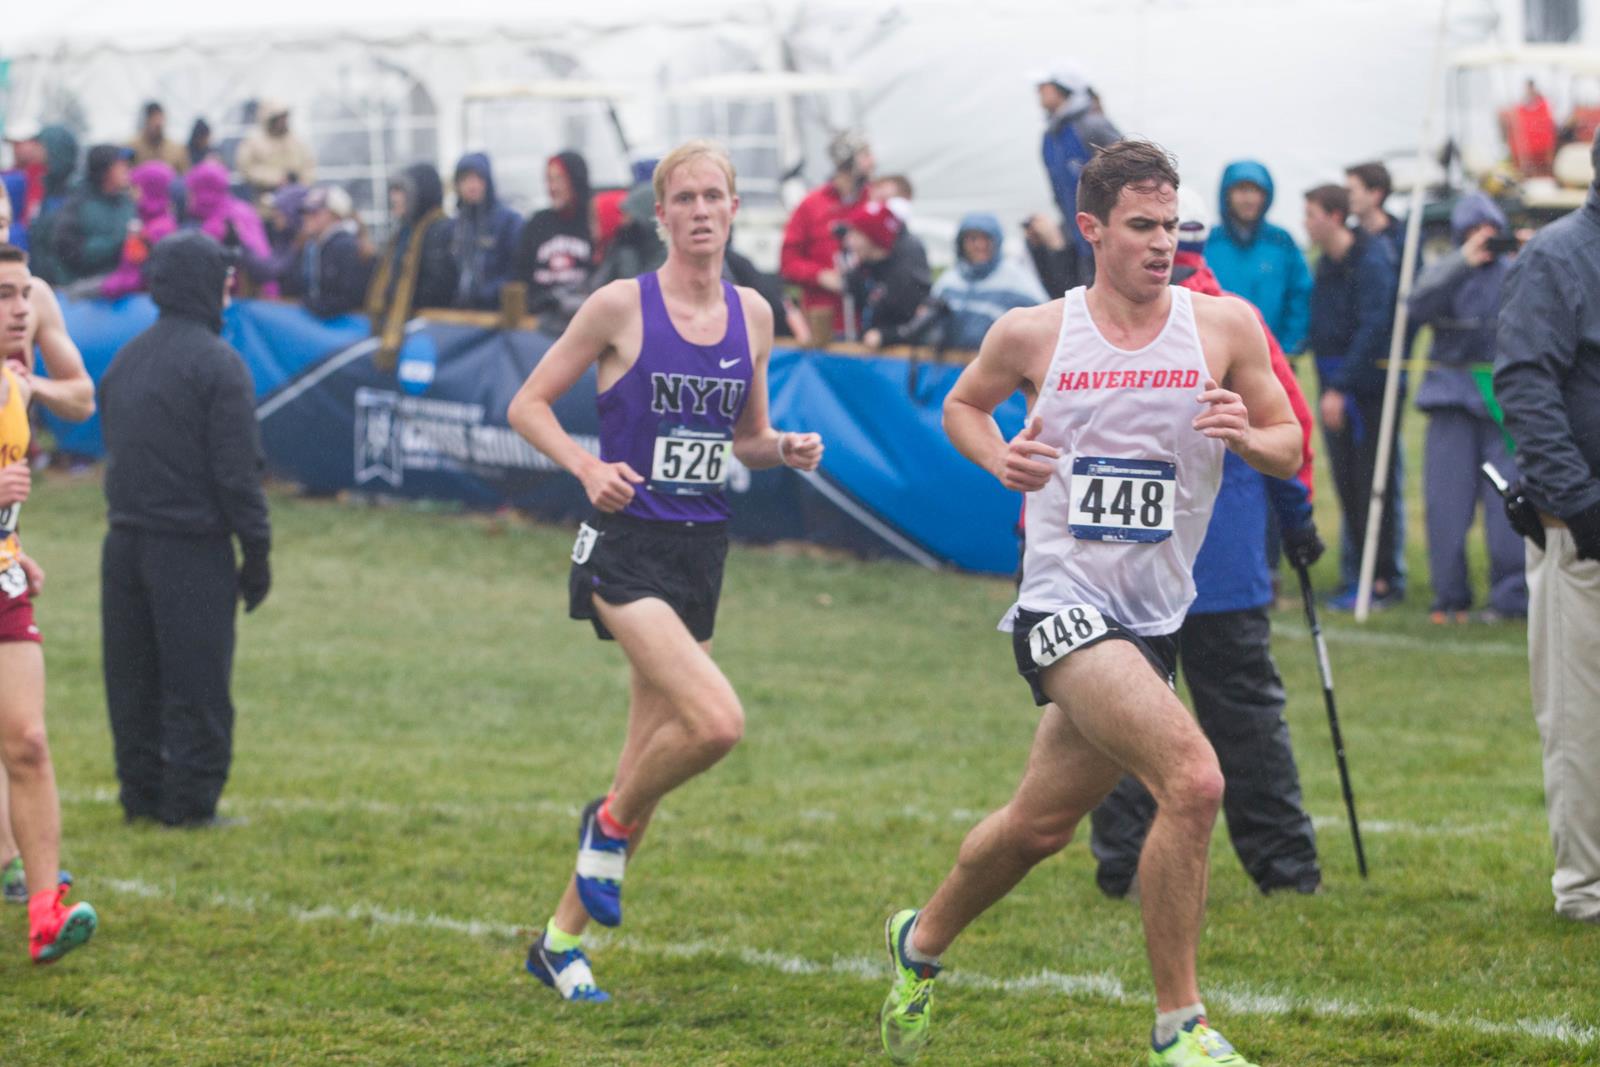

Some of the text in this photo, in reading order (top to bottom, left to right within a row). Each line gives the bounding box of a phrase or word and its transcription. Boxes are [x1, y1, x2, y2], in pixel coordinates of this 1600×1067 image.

[651, 373, 745, 418] NYU
[1057, 369, 1199, 391] HAVERFORD
[662, 441, 726, 481] 526
[1080, 478, 1164, 528] 448
[1037, 606, 1093, 658] 448
